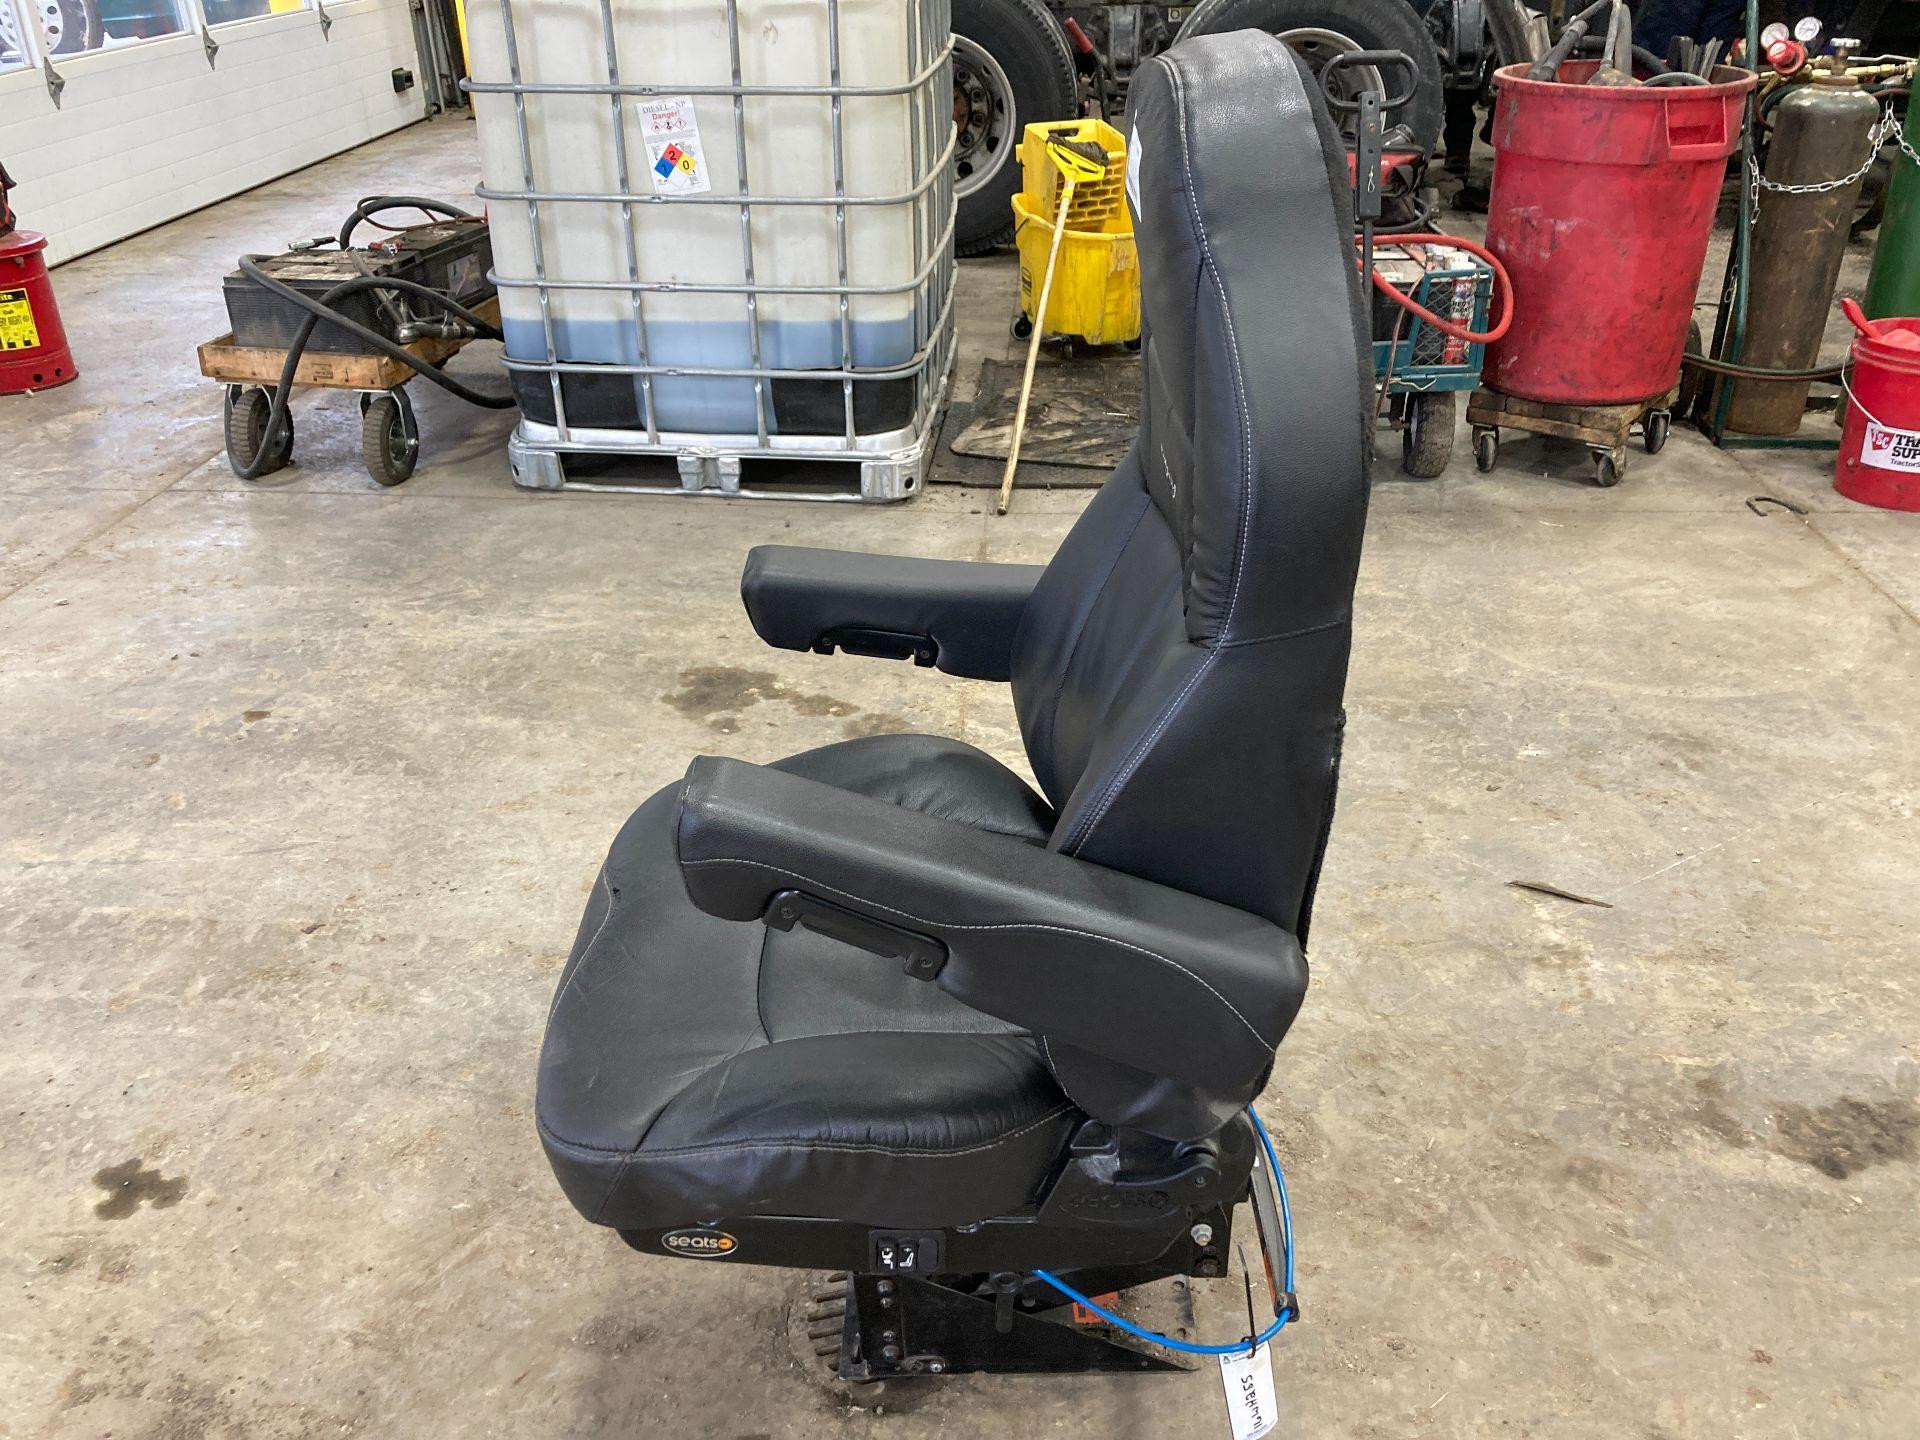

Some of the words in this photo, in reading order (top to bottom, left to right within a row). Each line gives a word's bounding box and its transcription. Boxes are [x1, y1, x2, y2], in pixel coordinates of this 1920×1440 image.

[642, 104, 669, 114] DIESEL
[652, 110, 680, 120] Danger!
[669, 150, 677, 161] 2
[661, 164, 668, 172] 1
[683, 160, 690, 170] 0
[1872, 429, 1890, 449] TSC
[1891, 446, 1920, 459] SUP
[668, 1236, 718, 1249] seats
